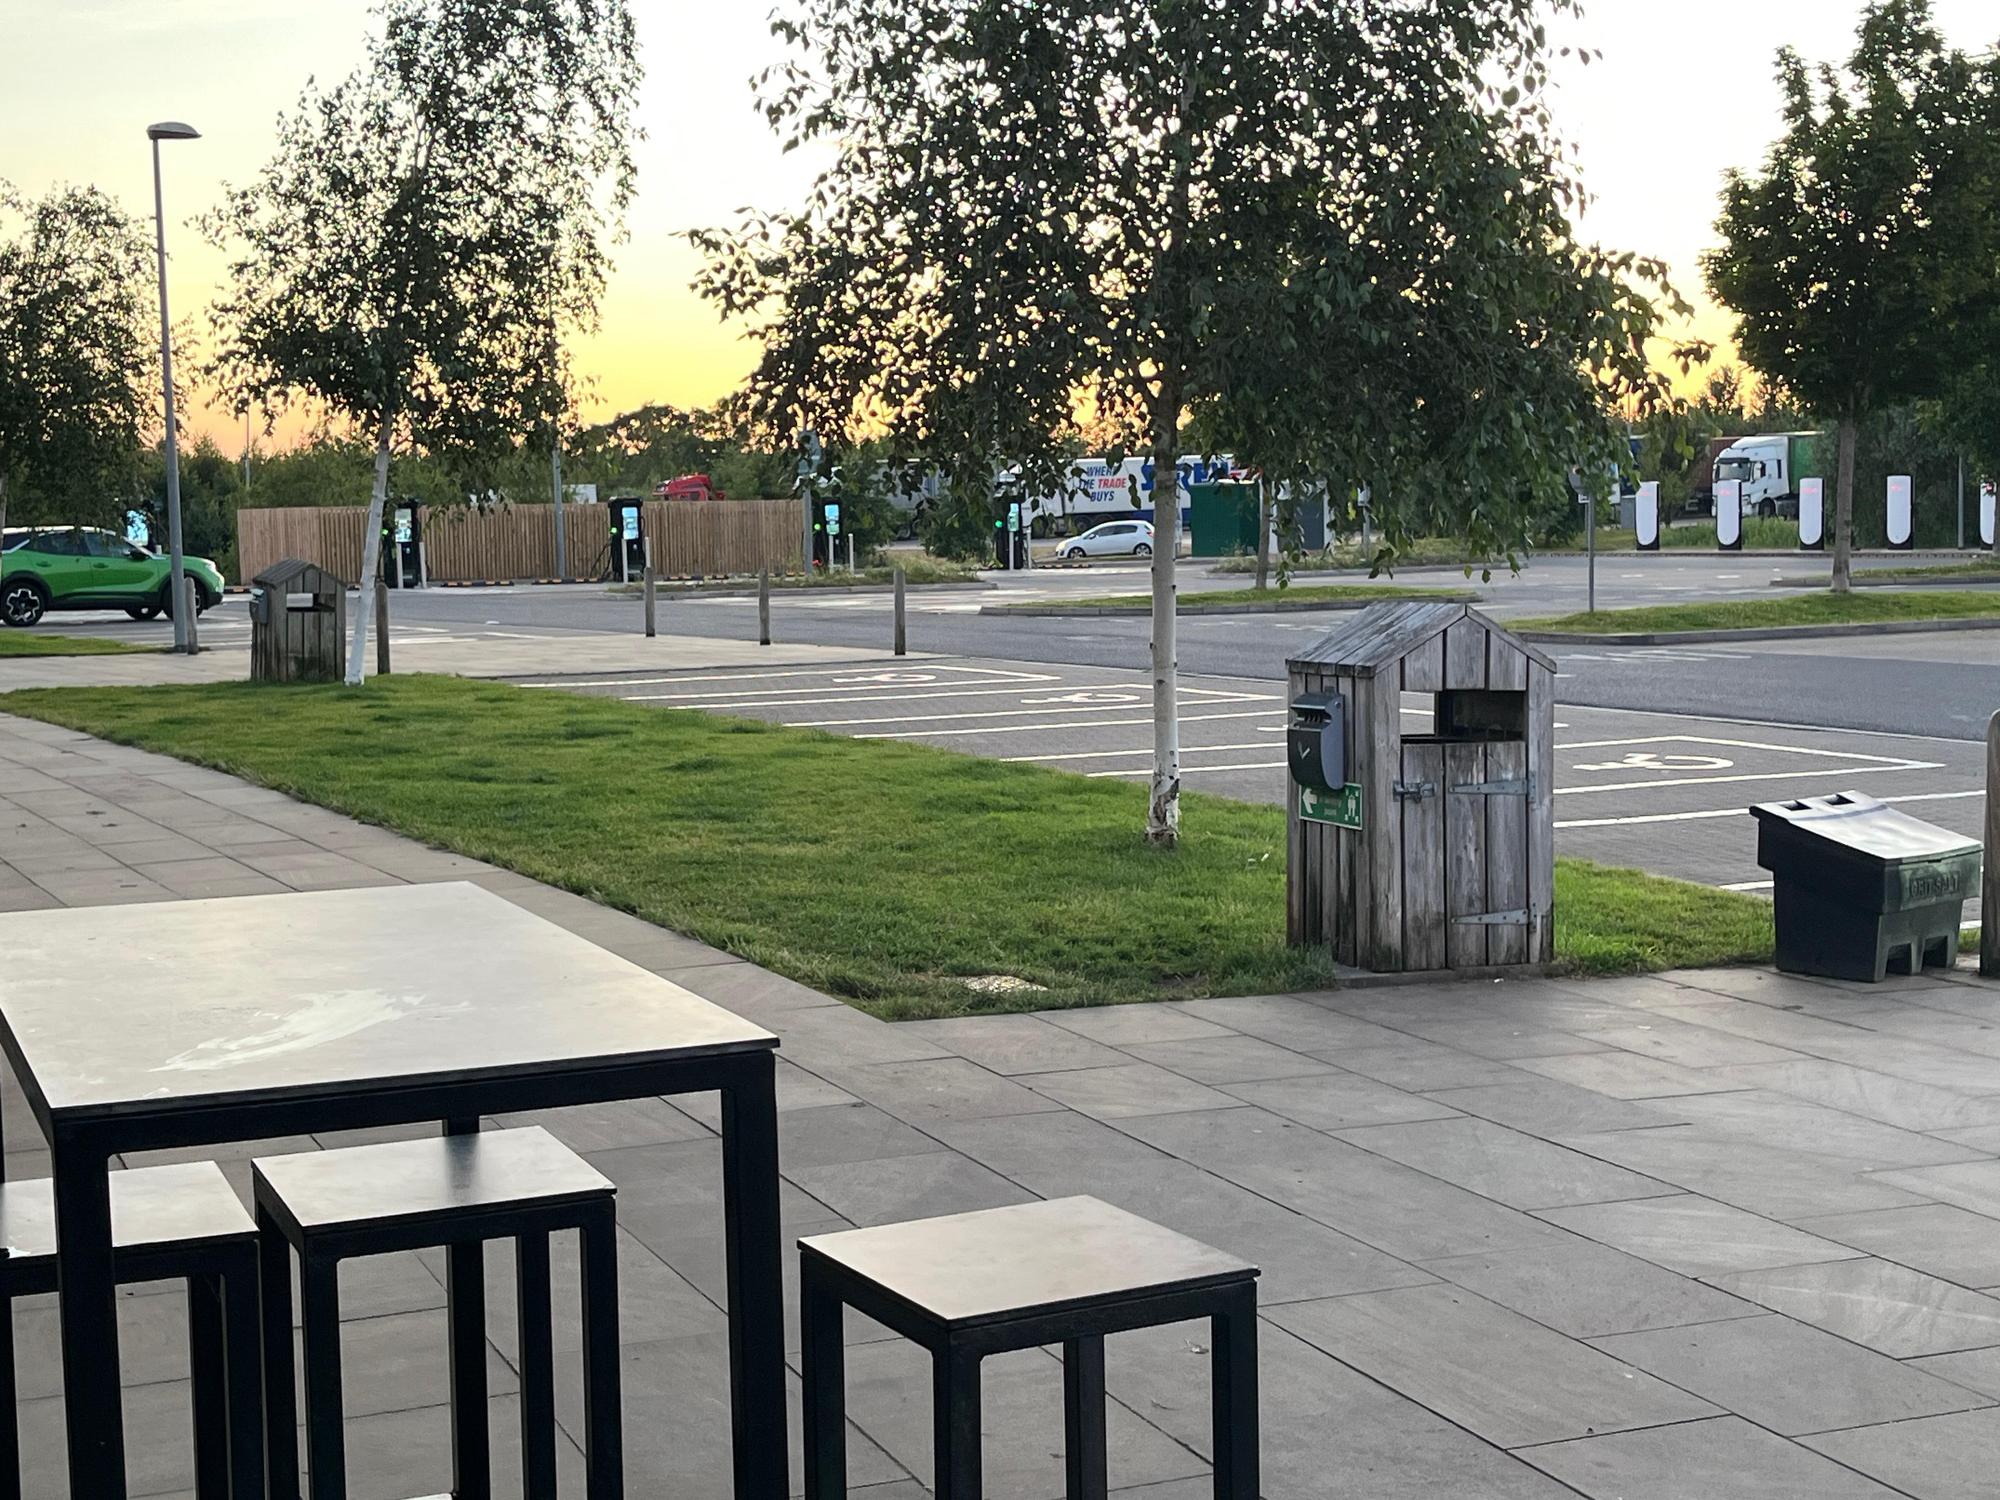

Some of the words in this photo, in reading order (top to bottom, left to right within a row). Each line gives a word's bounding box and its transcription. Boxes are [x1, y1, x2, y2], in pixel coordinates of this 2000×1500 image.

[1086, 466, 1117, 477] WHER
[1098, 478, 1127, 489] TRADE
[1090, 491, 1115, 502] BUYS
